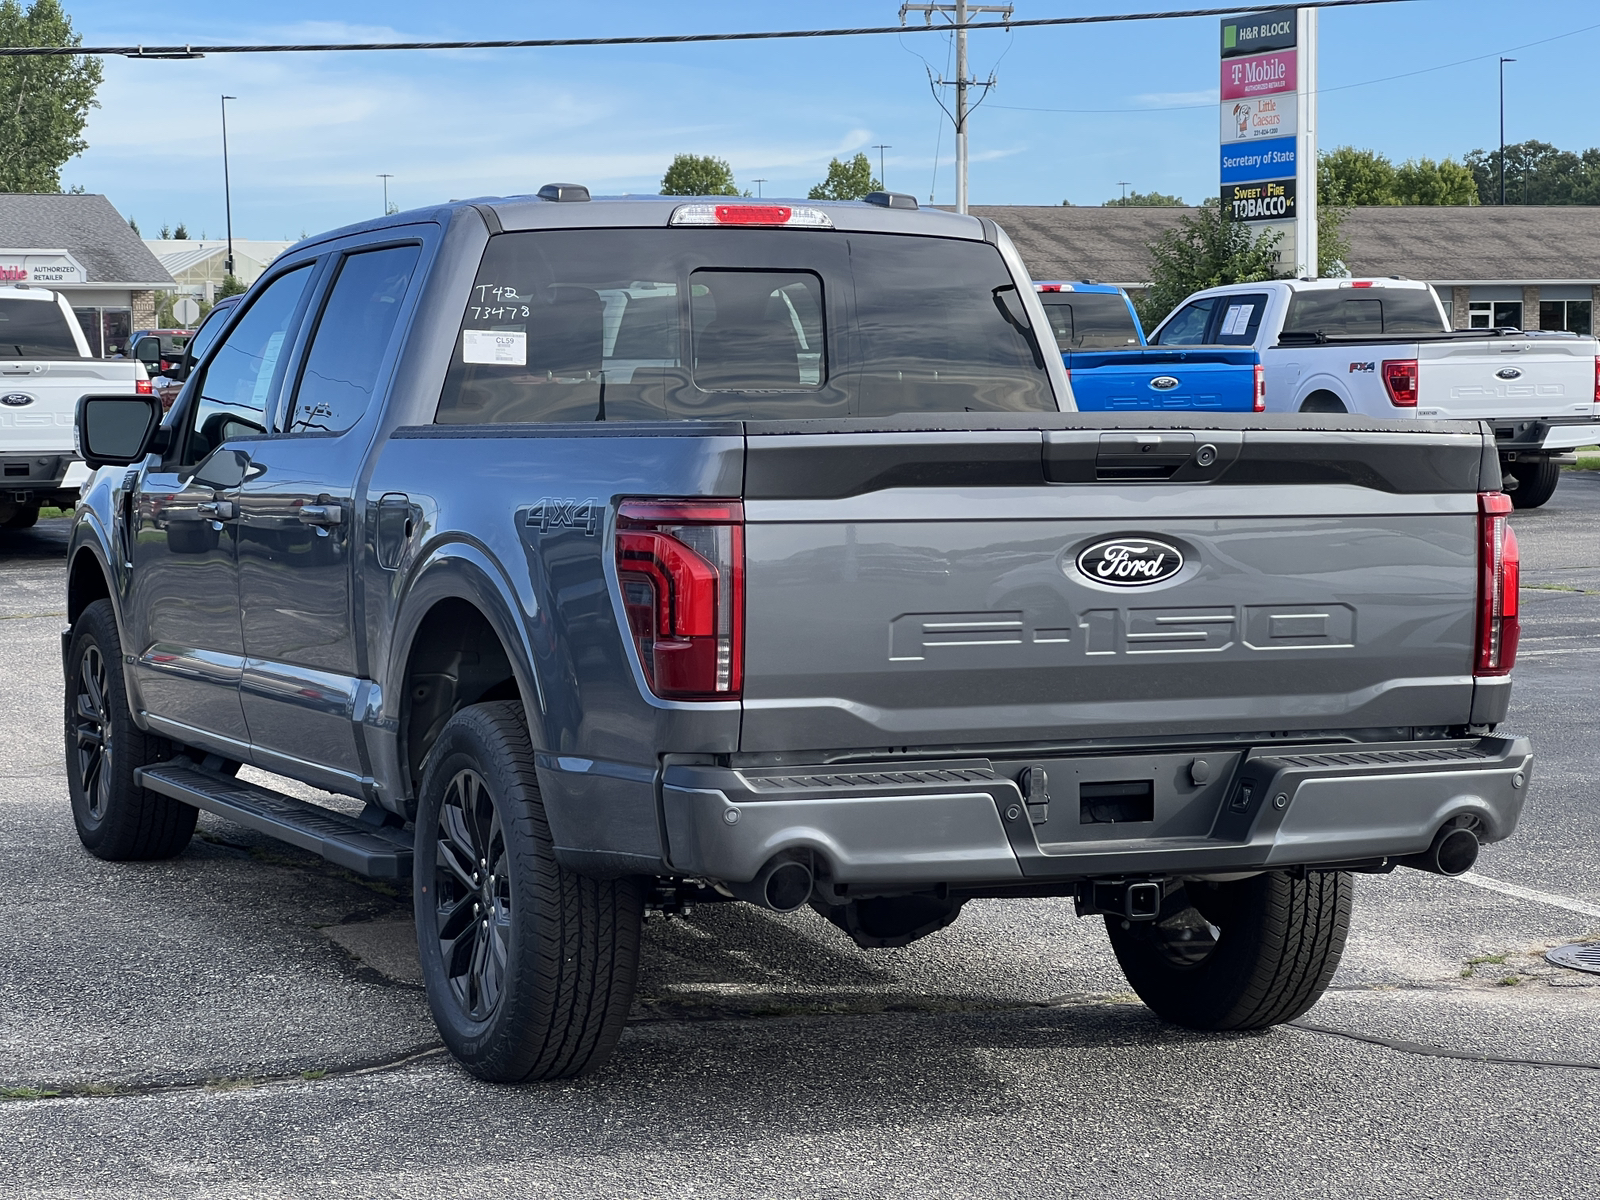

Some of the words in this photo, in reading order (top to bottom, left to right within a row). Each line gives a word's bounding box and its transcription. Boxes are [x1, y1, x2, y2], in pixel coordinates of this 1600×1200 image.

[1239, 27, 1259, 40] H&R
[1260, 21, 1291, 37] BLOCK
[1245, 58, 1286, 83] Mobile
[1258, 99, 1276, 113] Little
[1252, 114, 1281, 127] Caesars
[1223, 155, 1261, 168] Secretary
[1262, 151, 1272, 164] of
[1272, 151, 1295, 163] State
[1232, 196, 1286, 218] TOBACCO
[471, 306, 530, 320] 73478
[495, 337, 515, 345] CL59
[1349, 362, 1376, 374] FX4
[1450, 383, 1566, 399] F-150
[1105, 393, 1223, 409] F-150
[1096, 545, 1165, 577] Ford
[888, 602, 1358, 662] F-150
